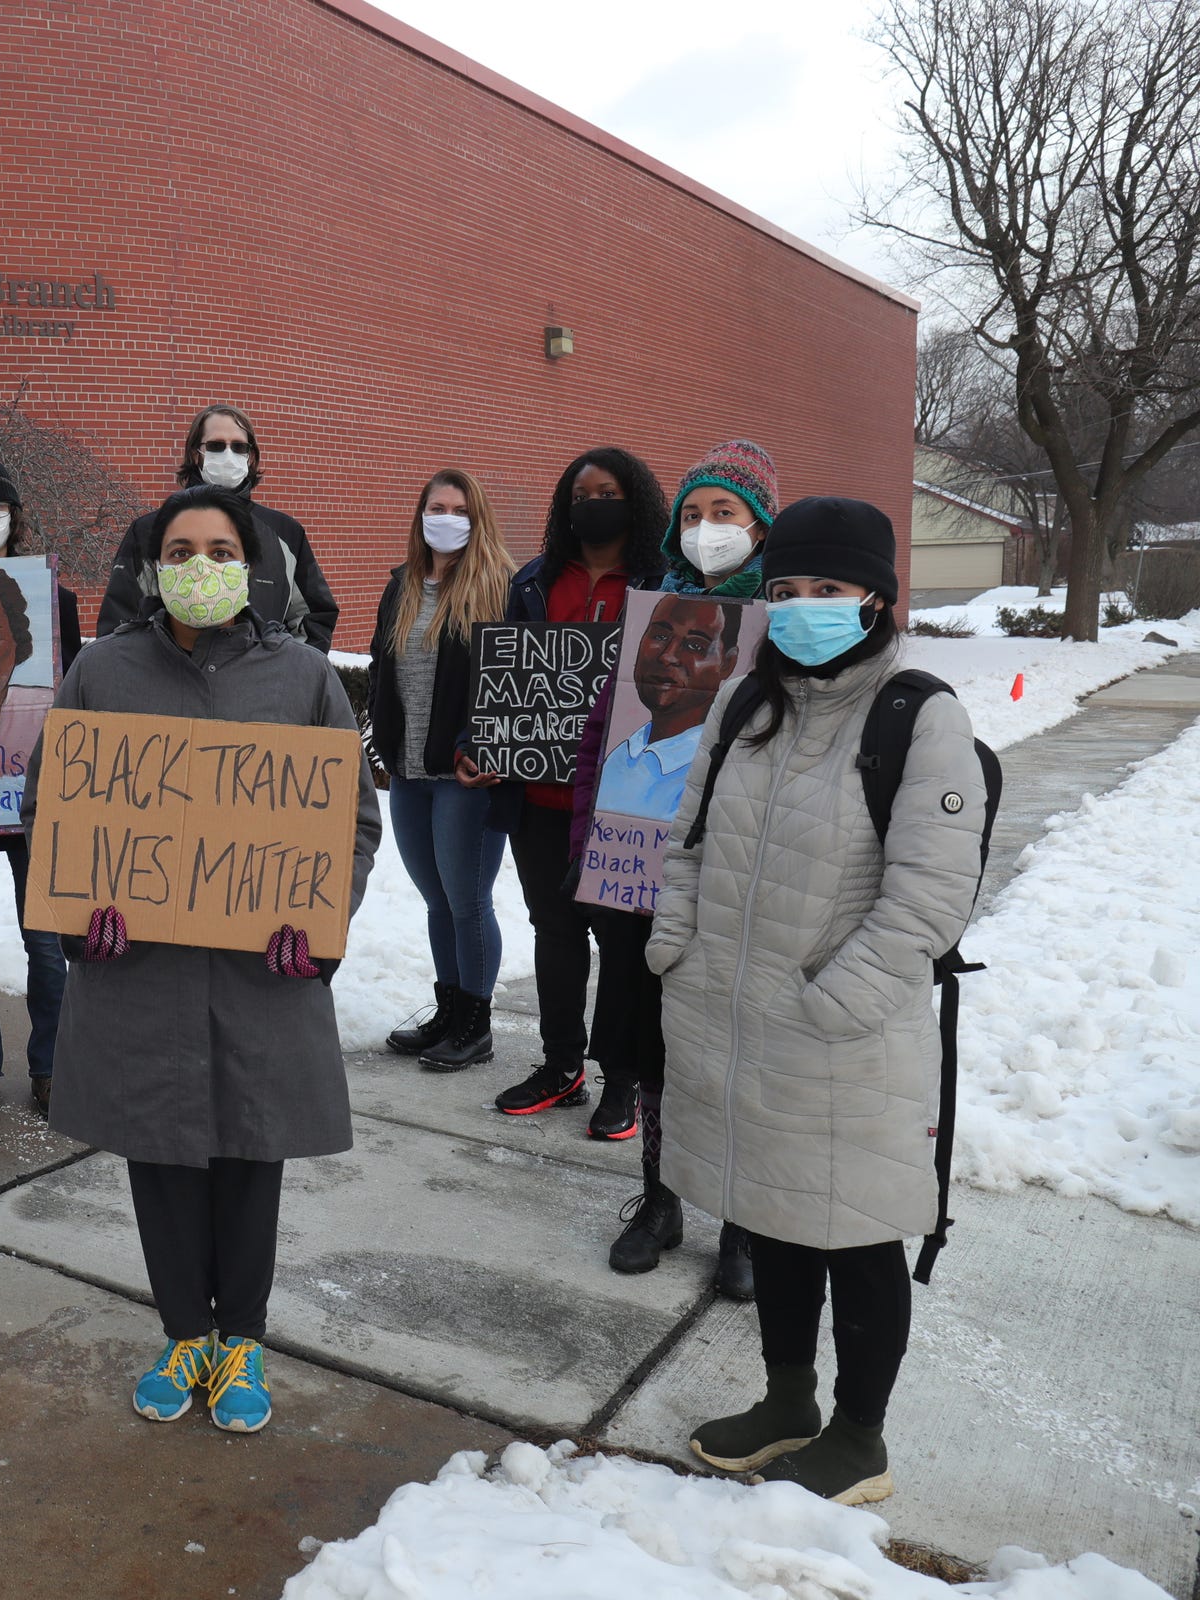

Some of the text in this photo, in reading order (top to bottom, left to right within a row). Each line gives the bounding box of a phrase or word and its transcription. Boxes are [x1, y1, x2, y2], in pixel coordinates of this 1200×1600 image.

[480, 627, 593, 673] END
[56, 720, 343, 811] BLACK TRANS
[590, 817, 645, 848] Kevin
[49, 821, 335, 916] LIVES MATTER
[584, 850, 647, 876] Black
